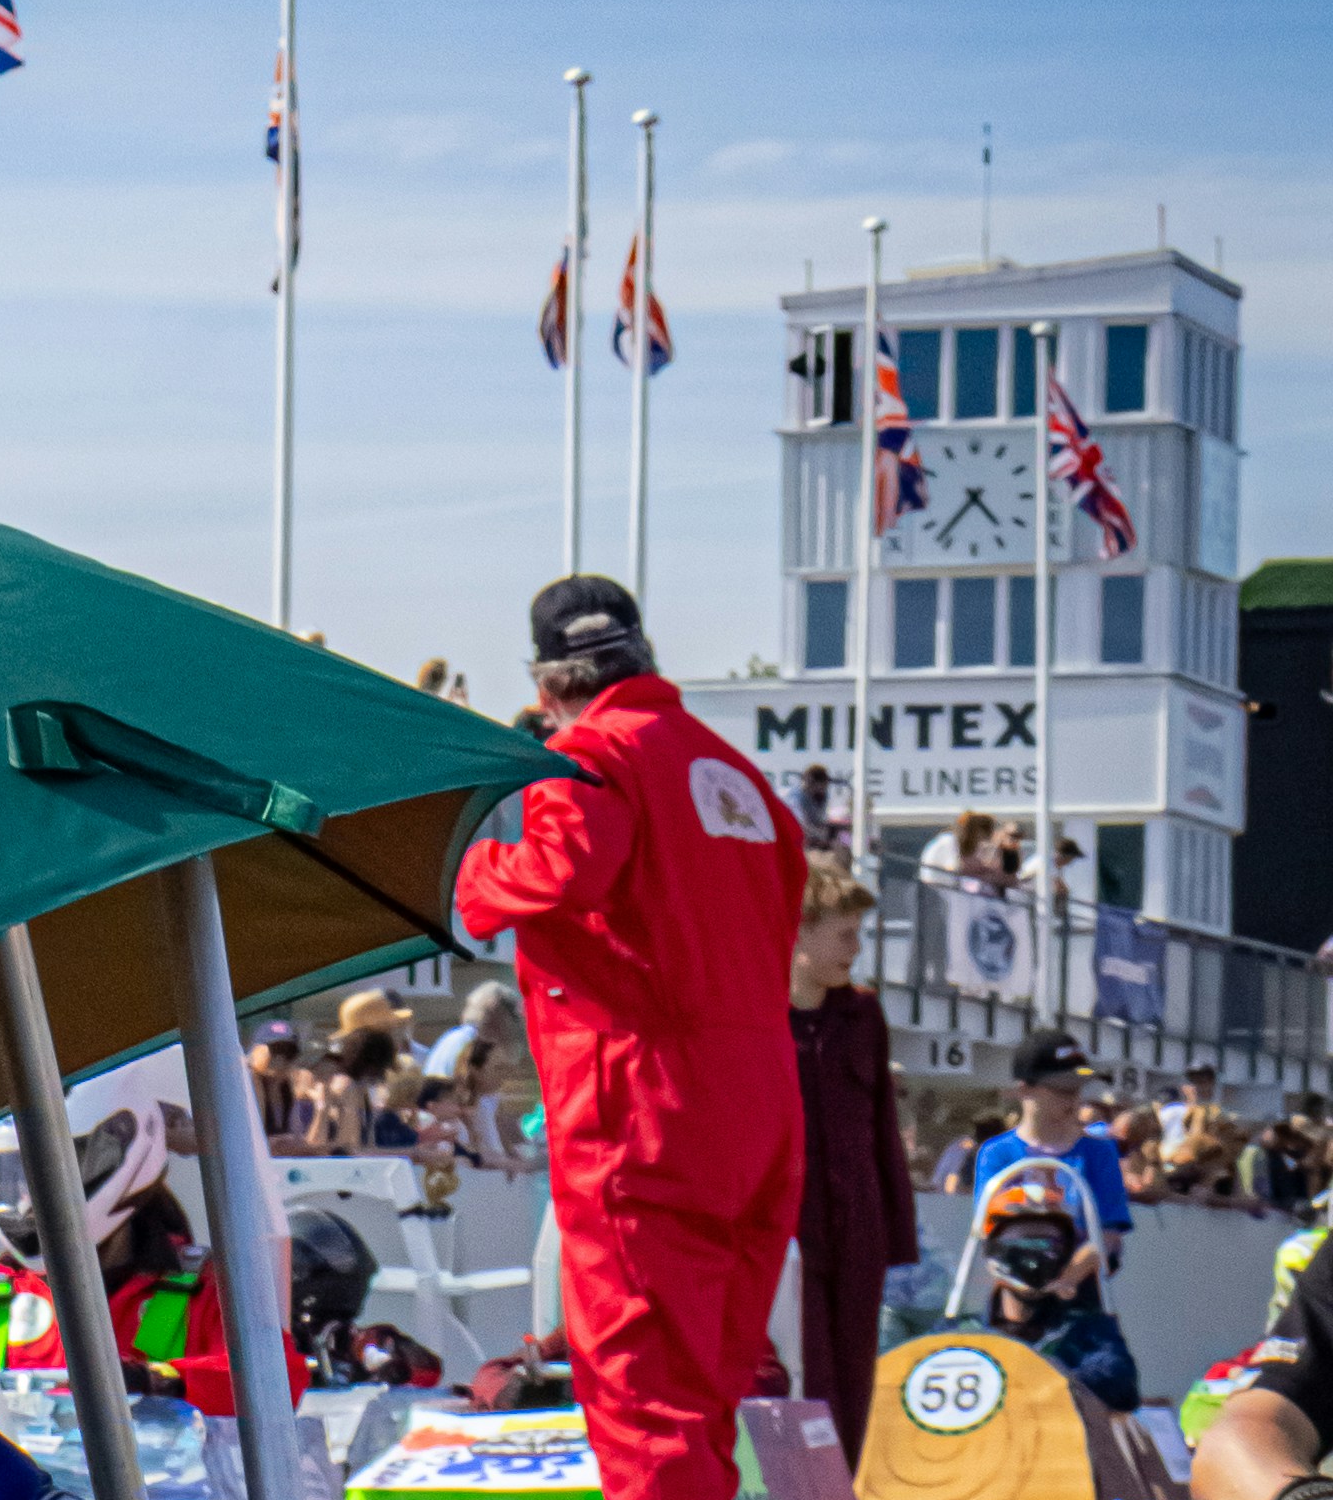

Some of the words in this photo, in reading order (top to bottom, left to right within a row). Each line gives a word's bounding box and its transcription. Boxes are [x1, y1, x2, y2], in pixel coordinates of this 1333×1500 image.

[757, 703, 1037, 751] MINTEX
[901, 766, 1038, 797] LINERS
[928, 1040, 964, 1067] 16
[920, 1373, 982, 1414] 58
